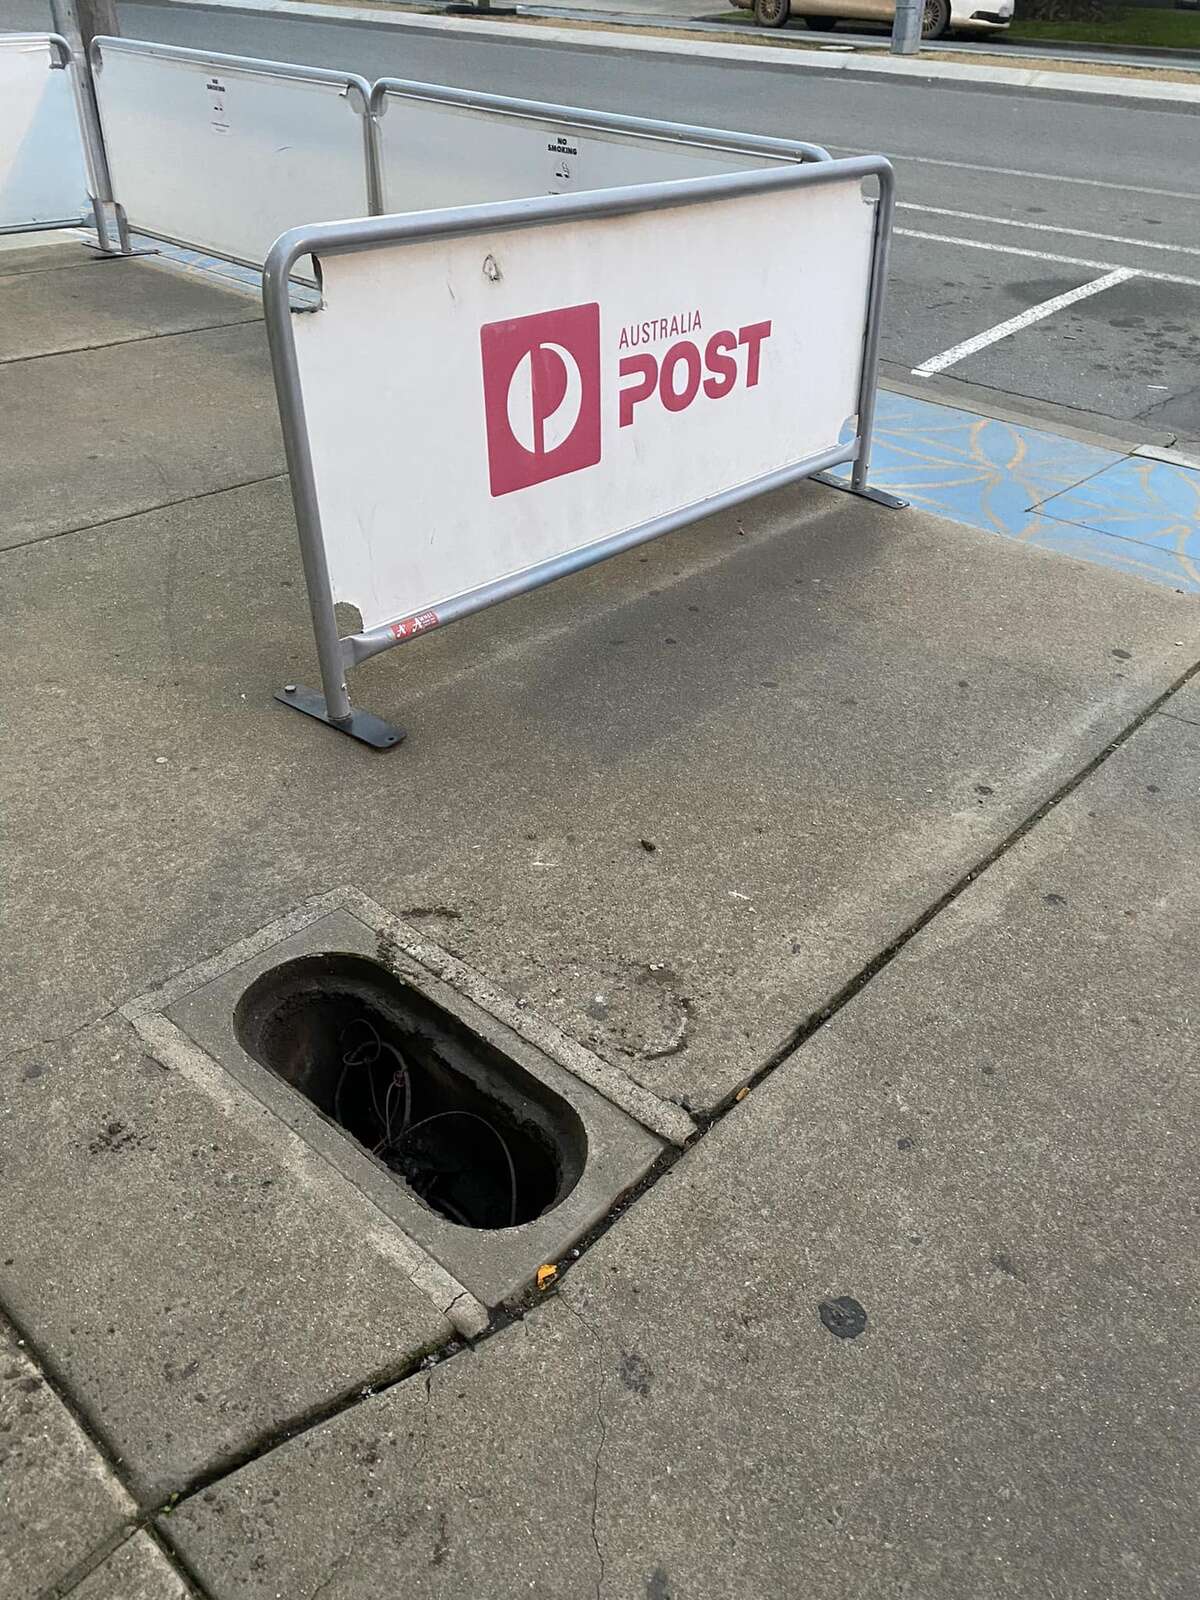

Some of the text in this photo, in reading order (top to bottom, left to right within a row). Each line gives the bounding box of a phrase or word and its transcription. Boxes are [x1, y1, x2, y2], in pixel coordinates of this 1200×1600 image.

[547, 144, 578, 156] SMOKING
[557, 137, 568, 146] NO
[619, 310, 702, 350] AUSTRALIA
[619, 320, 772, 428] POST
